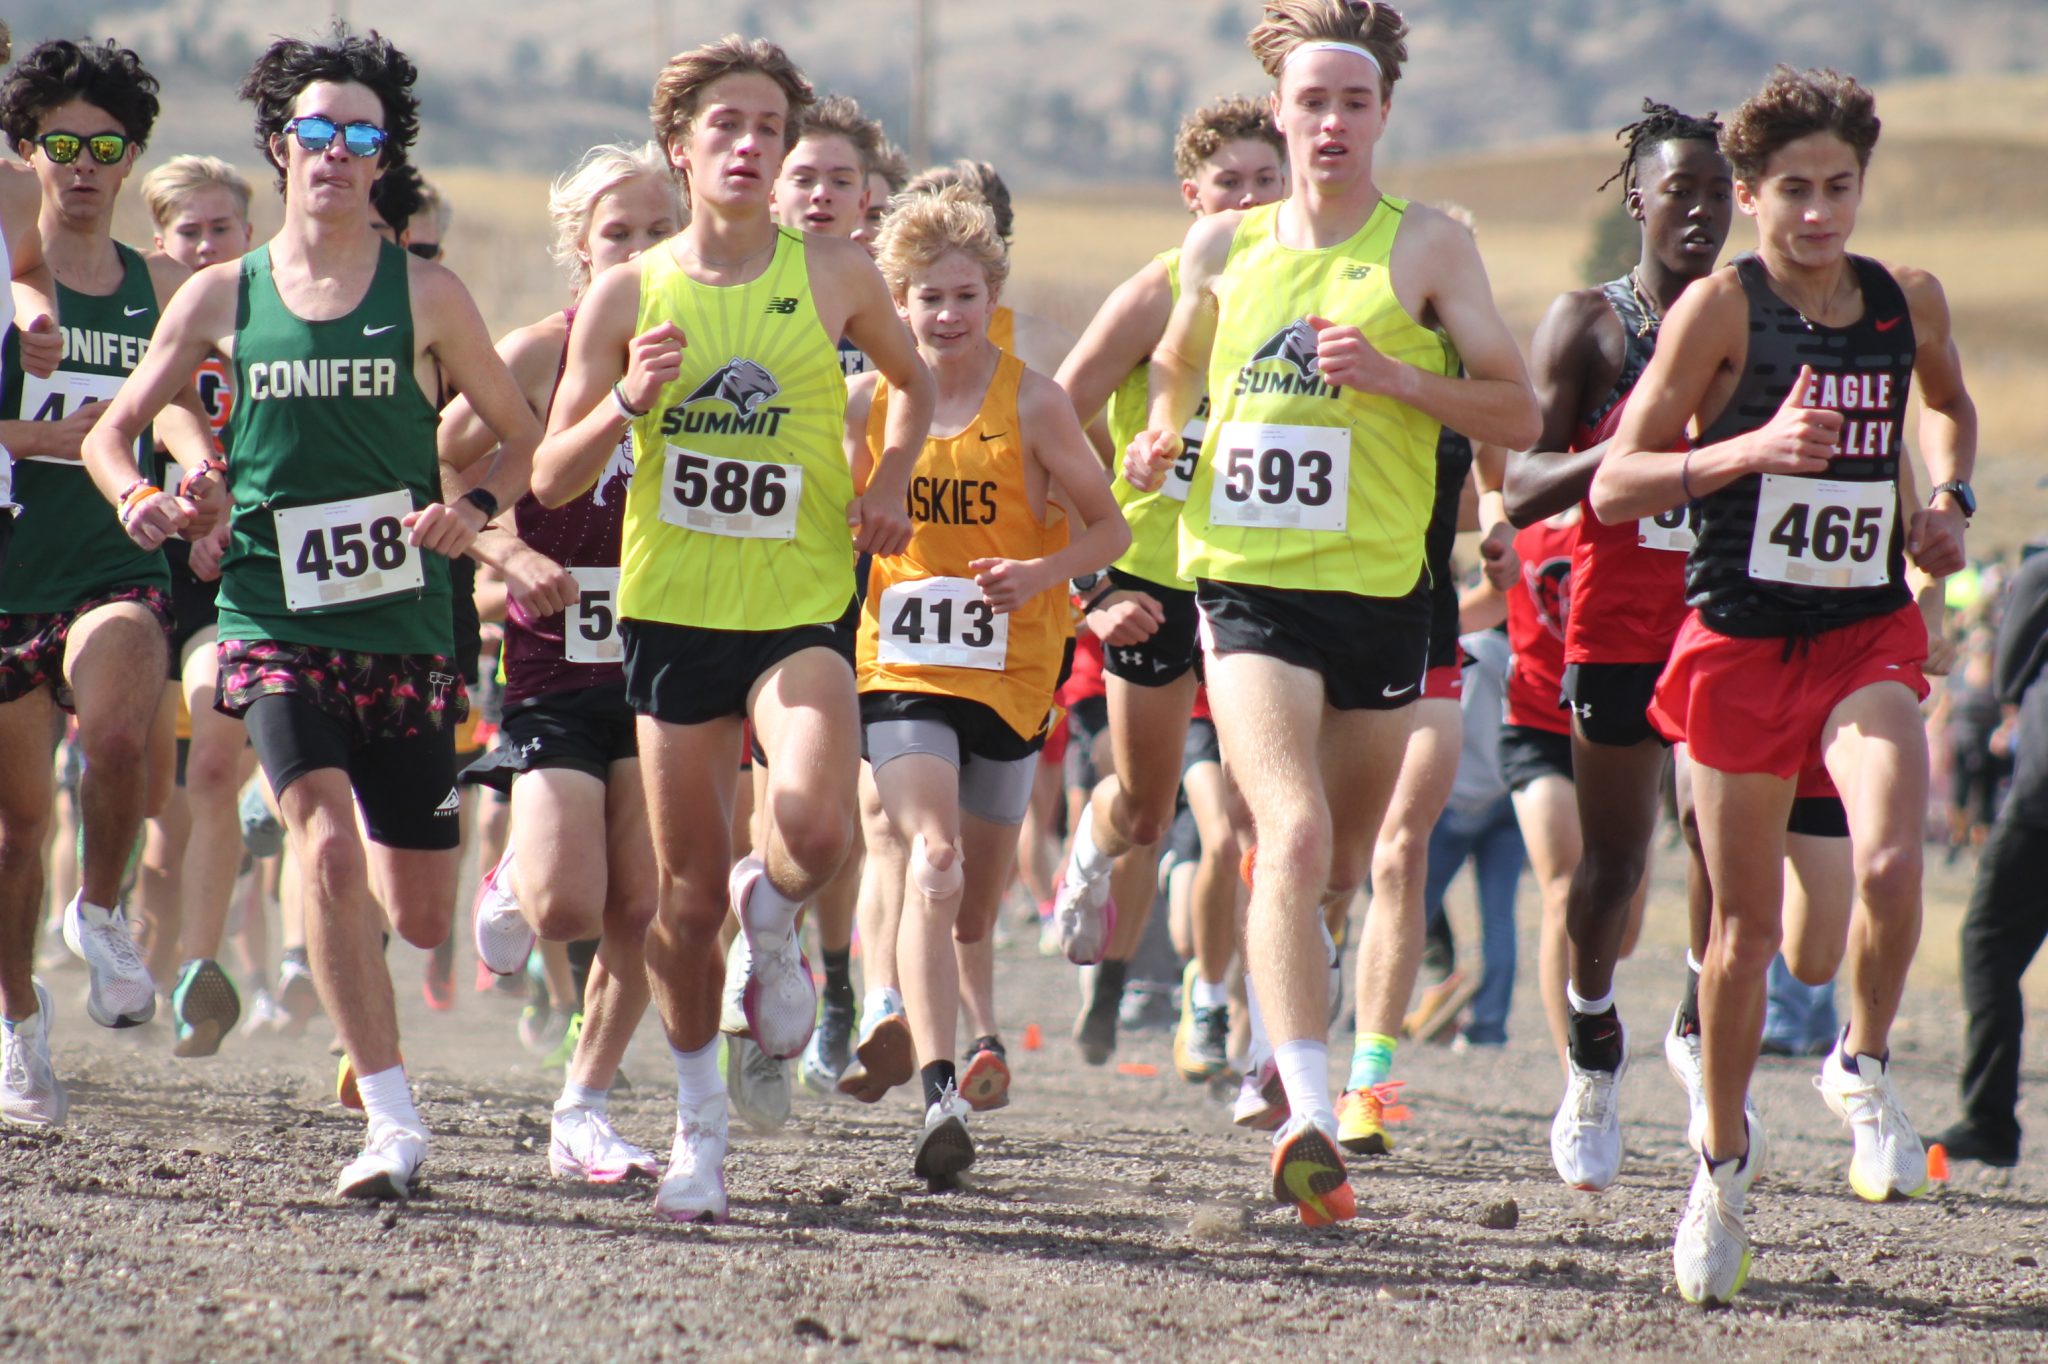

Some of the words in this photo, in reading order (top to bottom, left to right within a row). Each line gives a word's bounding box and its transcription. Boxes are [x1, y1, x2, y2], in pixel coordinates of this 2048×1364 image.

[249, 358, 396, 400] CONIFER
[1803, 374, 1890, 408] EAGLE
[660, 407, 790, 437] SUMMIT
[1830, 421, 1893, 454] LEY
[673, 453, 786, 516] 586
[907, 476, 997, 525] SKIES
[1225, 448, 1332, 506] 593
[296, 516, 406, 581] 458
[1769, 503, 1882, 562] 465
[892, 598, 994, 647] 413
